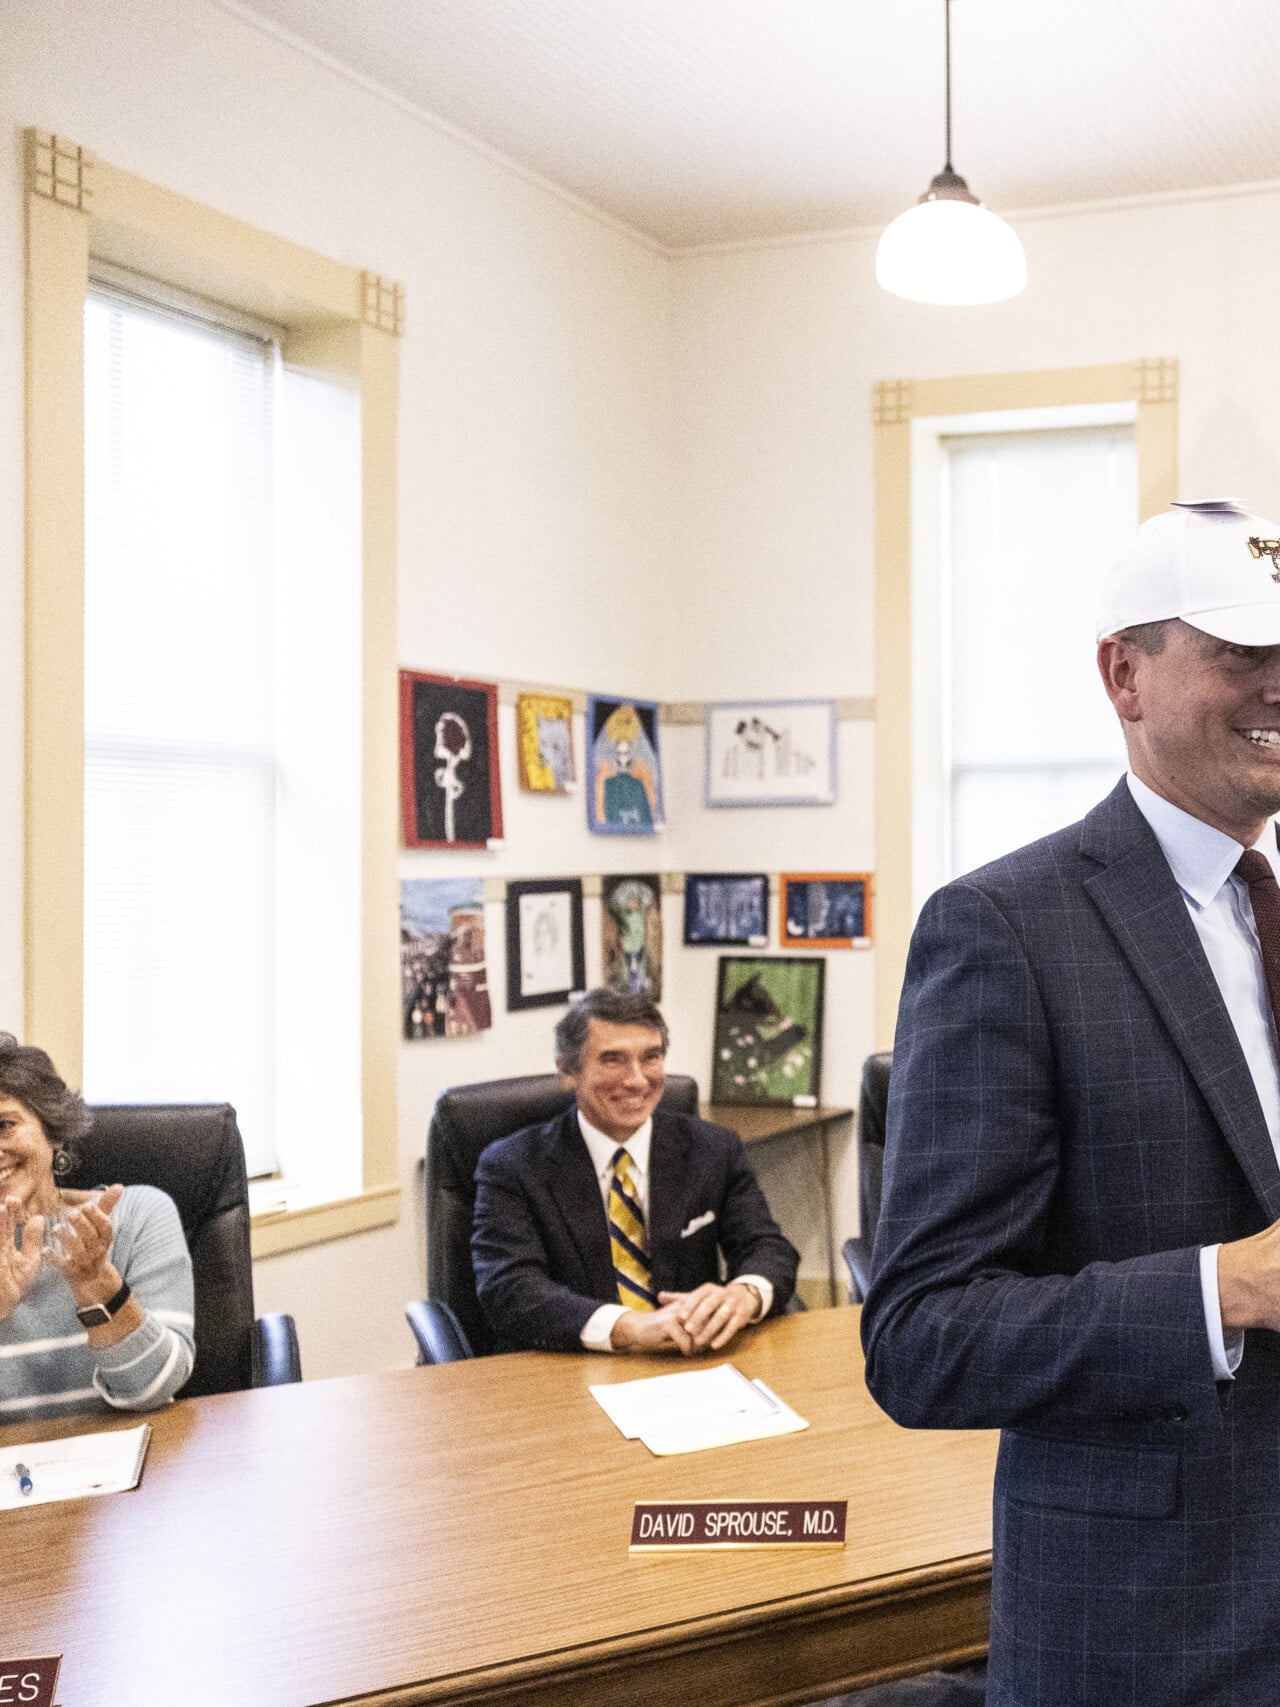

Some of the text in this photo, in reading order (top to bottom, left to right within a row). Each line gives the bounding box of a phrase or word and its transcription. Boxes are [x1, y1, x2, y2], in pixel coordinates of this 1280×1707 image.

[639, 1510, 838, 1538] DAVID SPROUSE, M.D.
